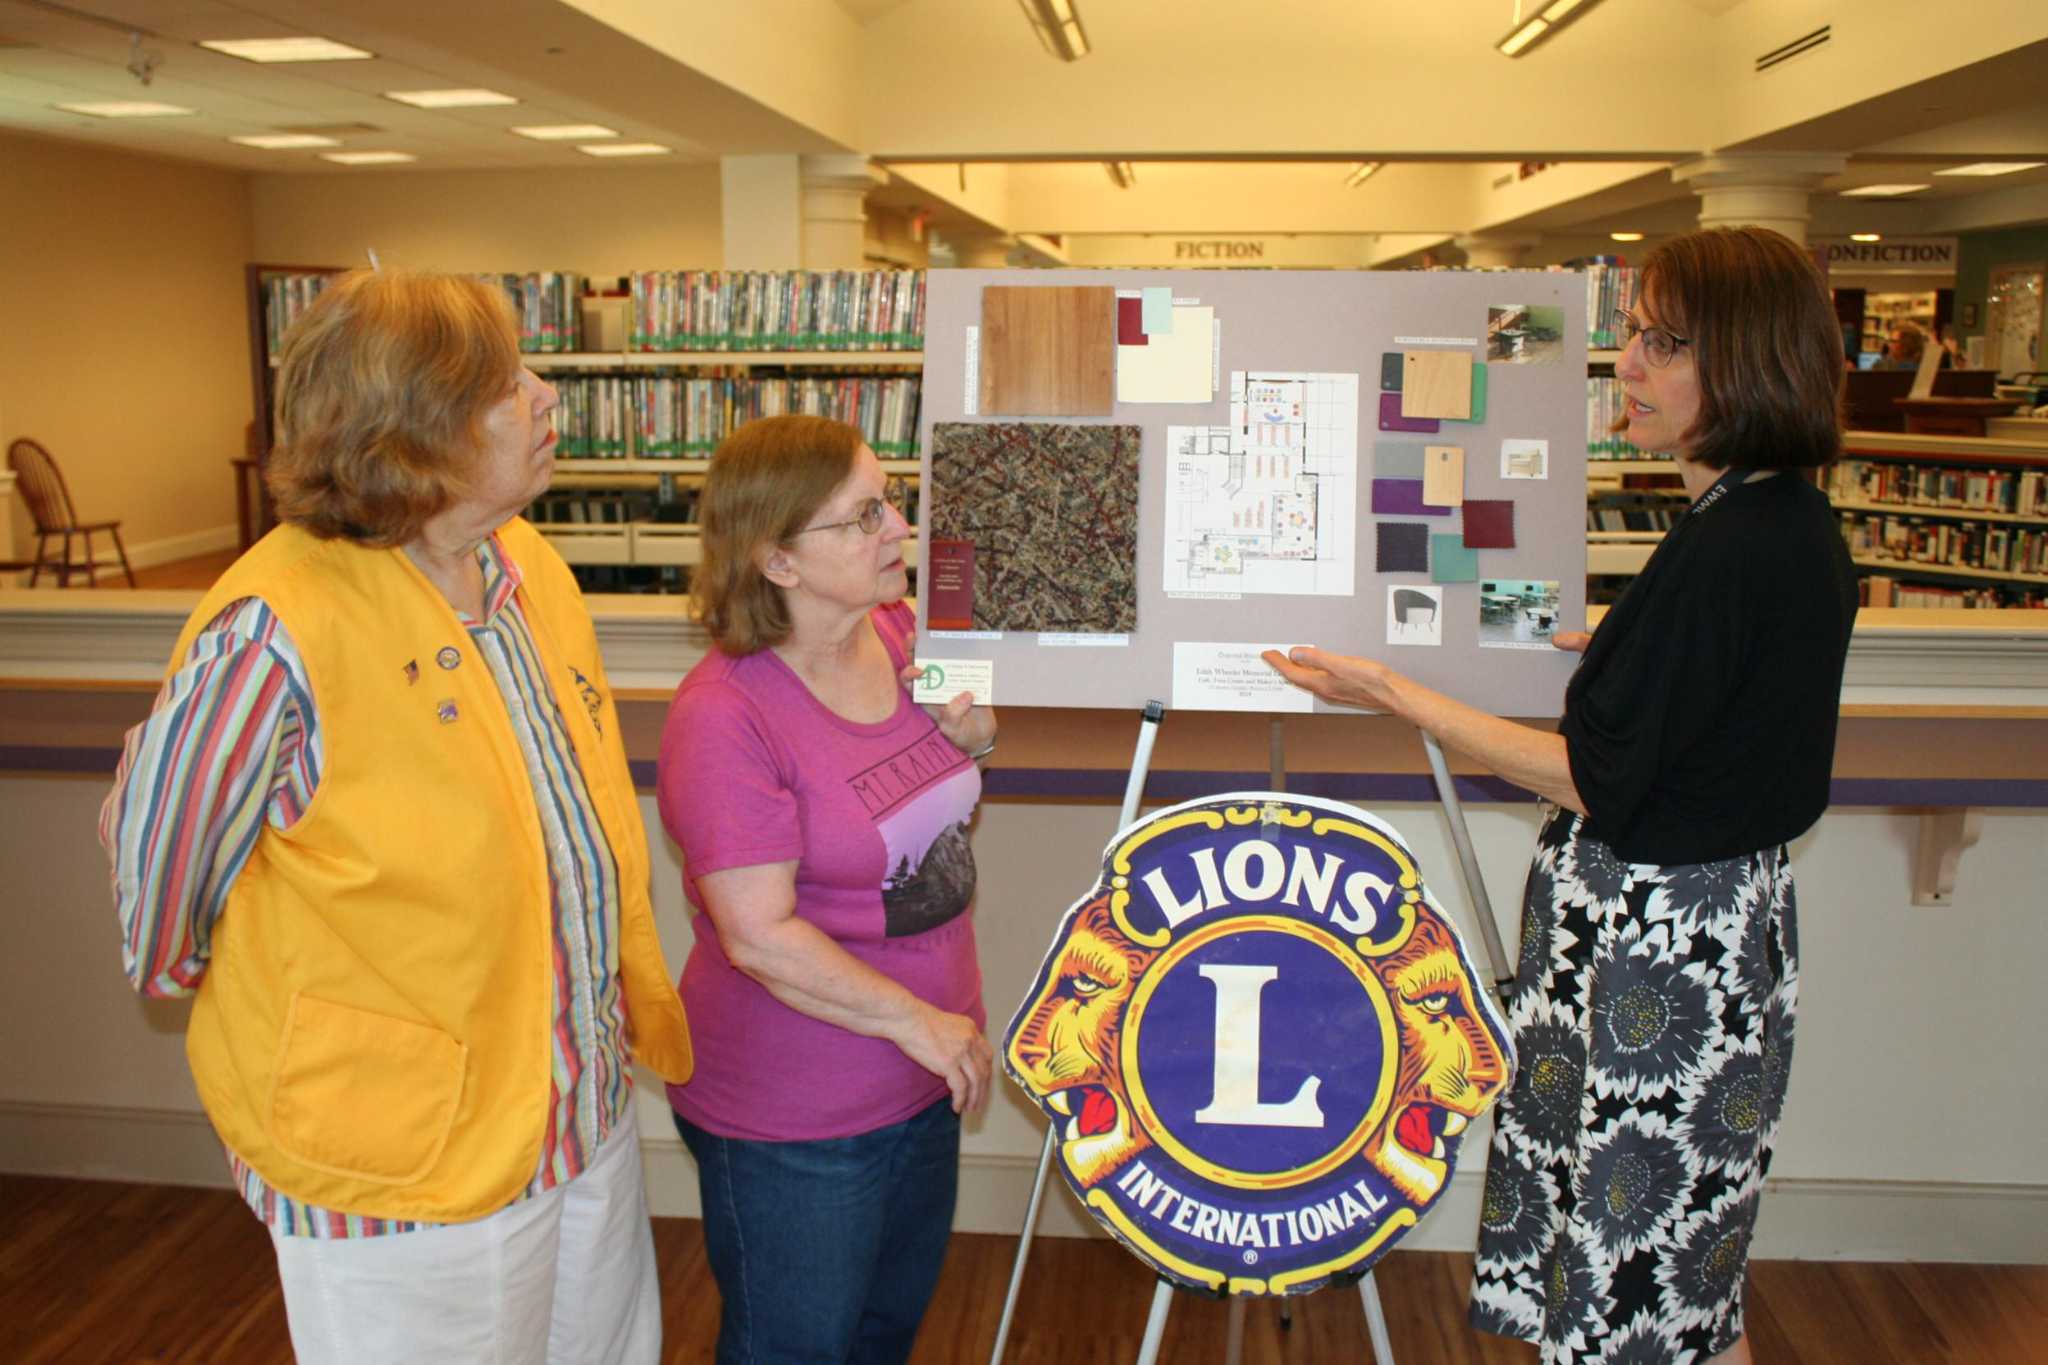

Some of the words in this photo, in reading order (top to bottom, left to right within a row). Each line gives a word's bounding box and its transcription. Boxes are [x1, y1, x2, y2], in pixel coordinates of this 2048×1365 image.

[1175, 241, 1264, 257] FICTION
[1827, 245, 1951, 262] ONFICTION
[852, 772, 896, 814] MT
[1142, 839, 1394, 935] LIONS
[1195, 964, 1325, 1128] L
[1117, 1160, 1388, 1248] INTERNATIONAL
